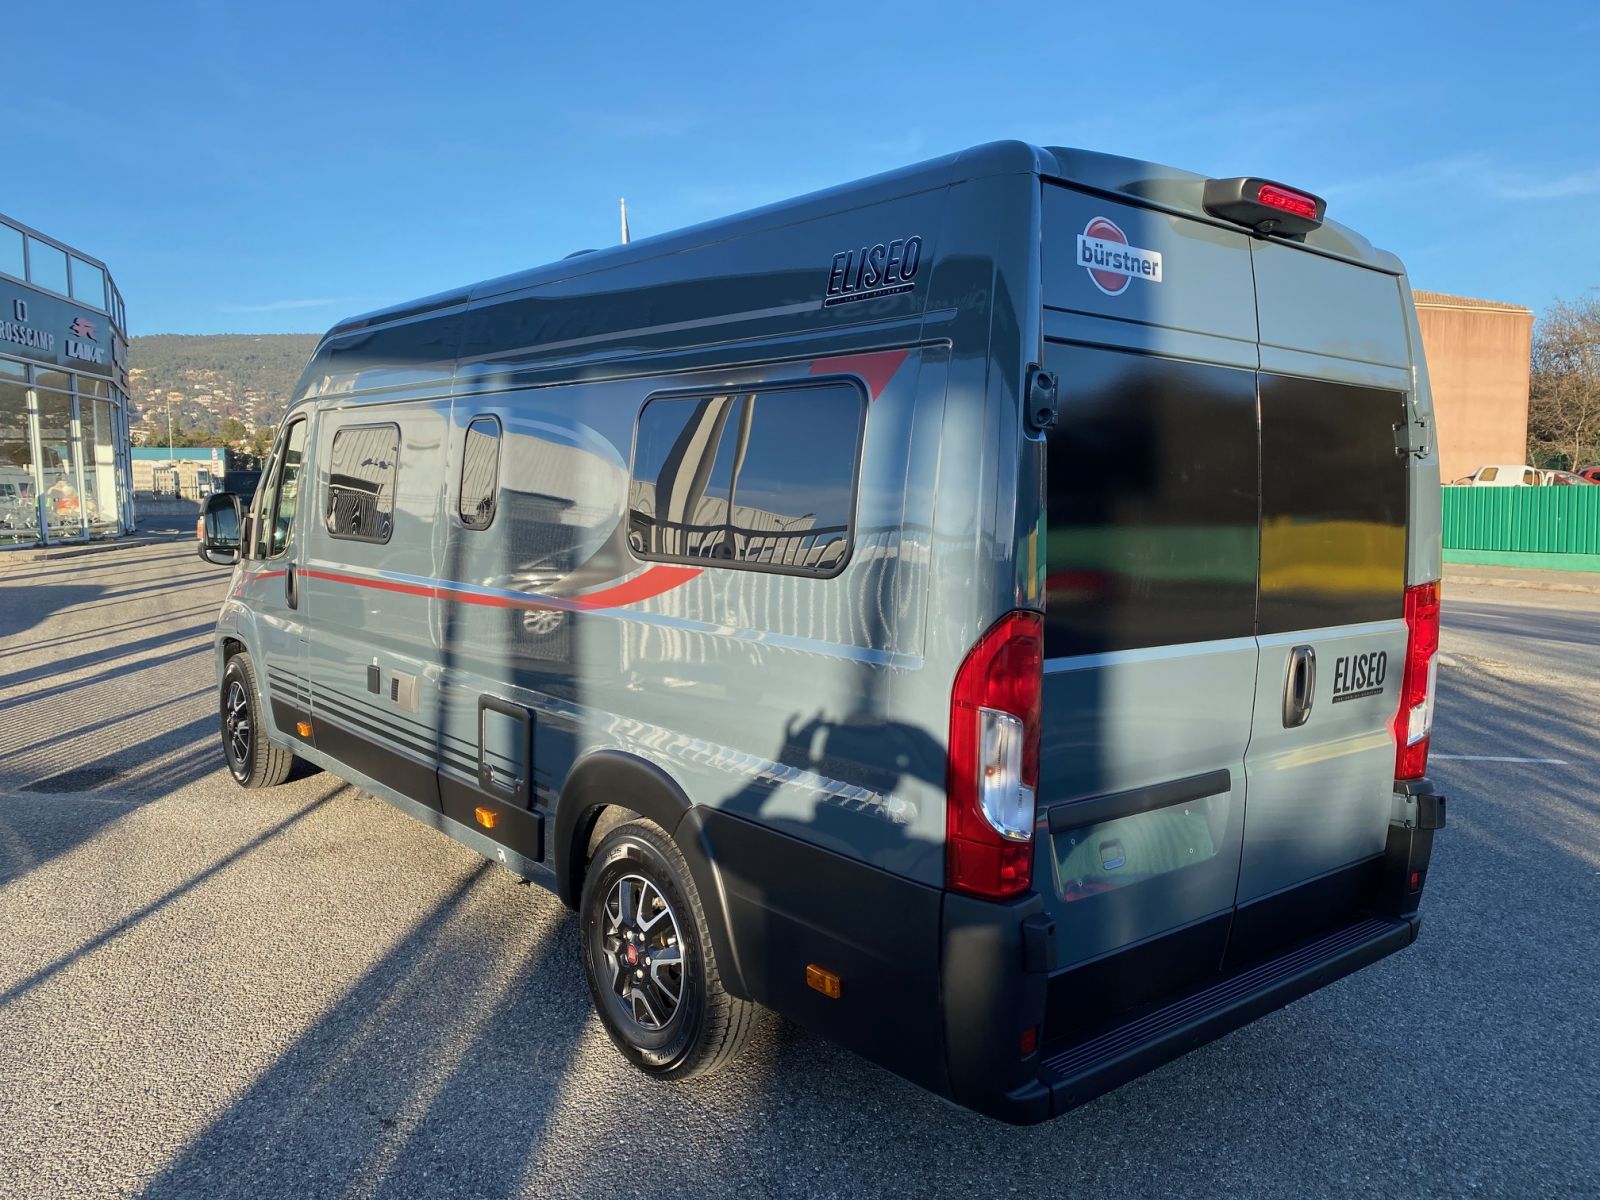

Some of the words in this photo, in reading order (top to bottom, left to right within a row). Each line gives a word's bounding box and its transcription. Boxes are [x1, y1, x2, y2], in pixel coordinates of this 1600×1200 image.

[825, 235, 922, 297] ELISEO
[1082, 239, 1159, 276] bürstner
[66, 339, 105, 365] LAIKA
[1333, 650, 1388, 695] ELISEO
